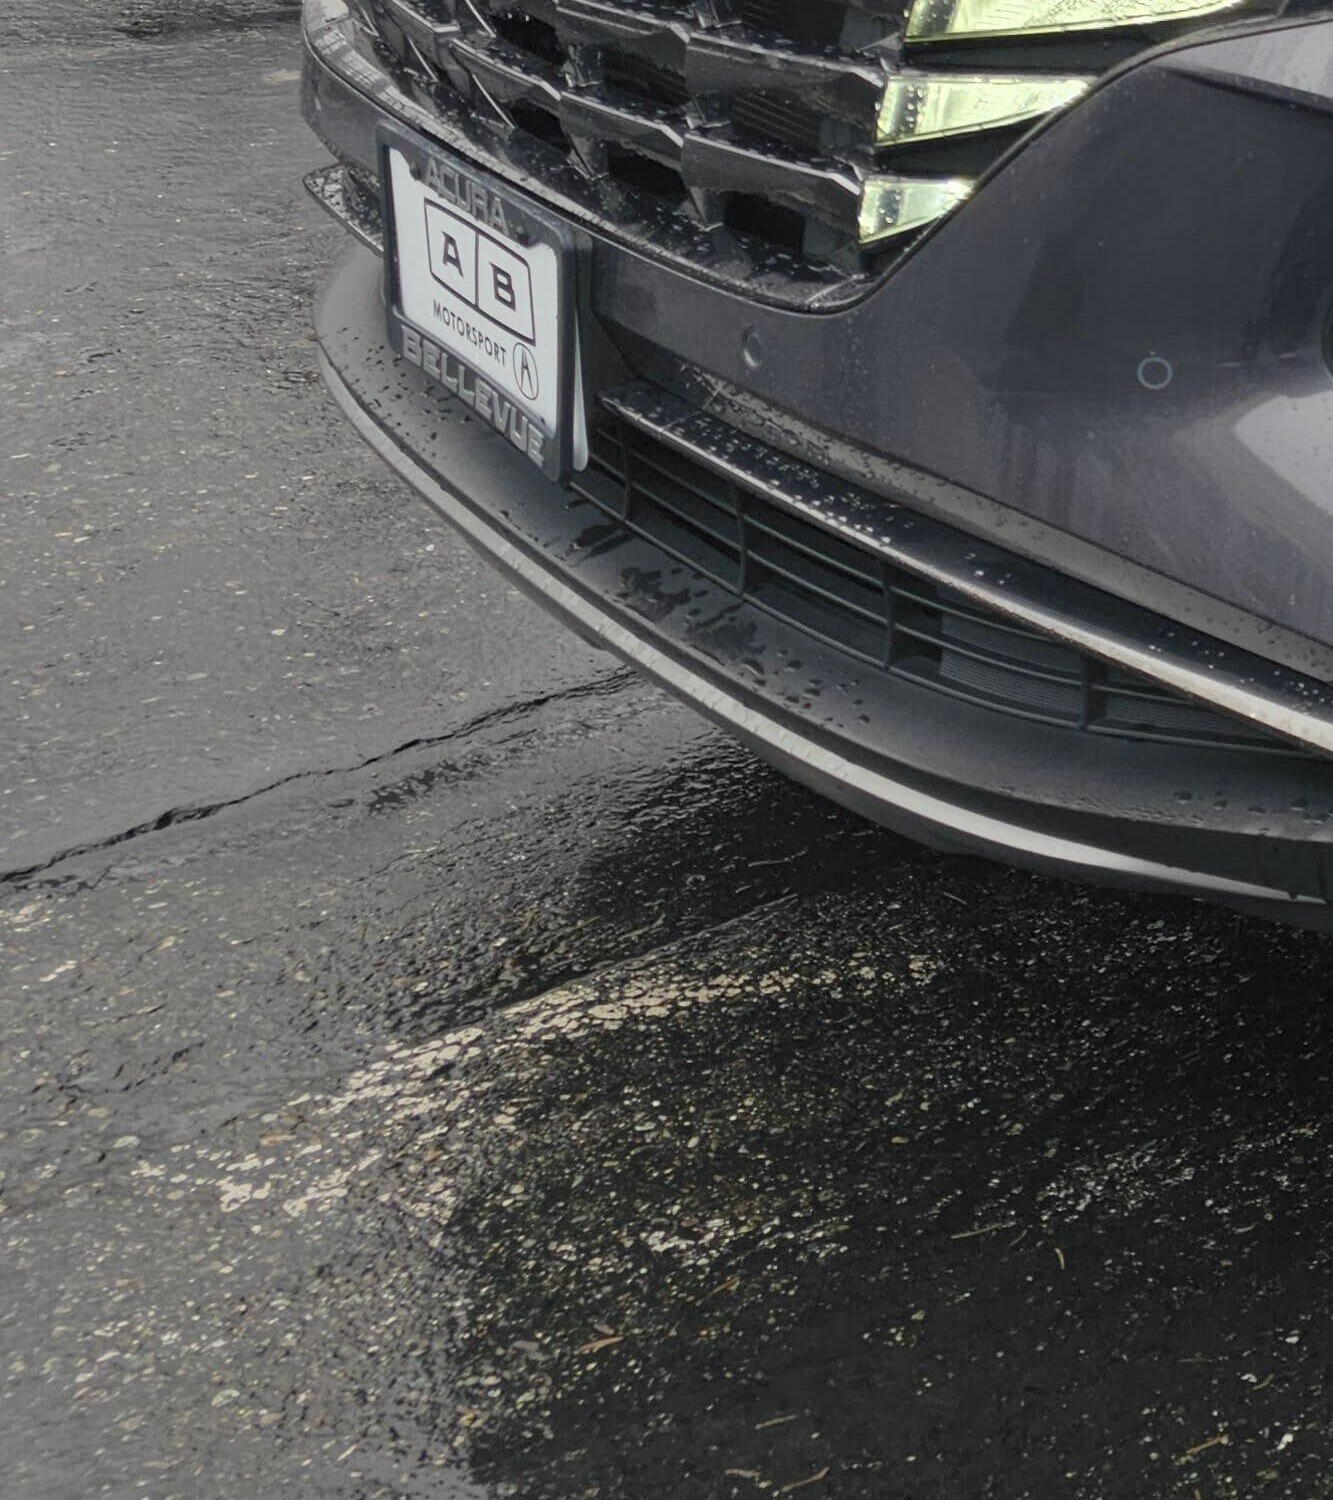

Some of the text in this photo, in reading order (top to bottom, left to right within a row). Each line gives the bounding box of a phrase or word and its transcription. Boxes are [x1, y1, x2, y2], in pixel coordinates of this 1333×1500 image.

[424, 160, 510, 236] ACURA
[442, 231, 516, 311] A B
[433, 299, 507, 367] MOTORSPORT
[401, 325, 545, 469] BELLEVUE
